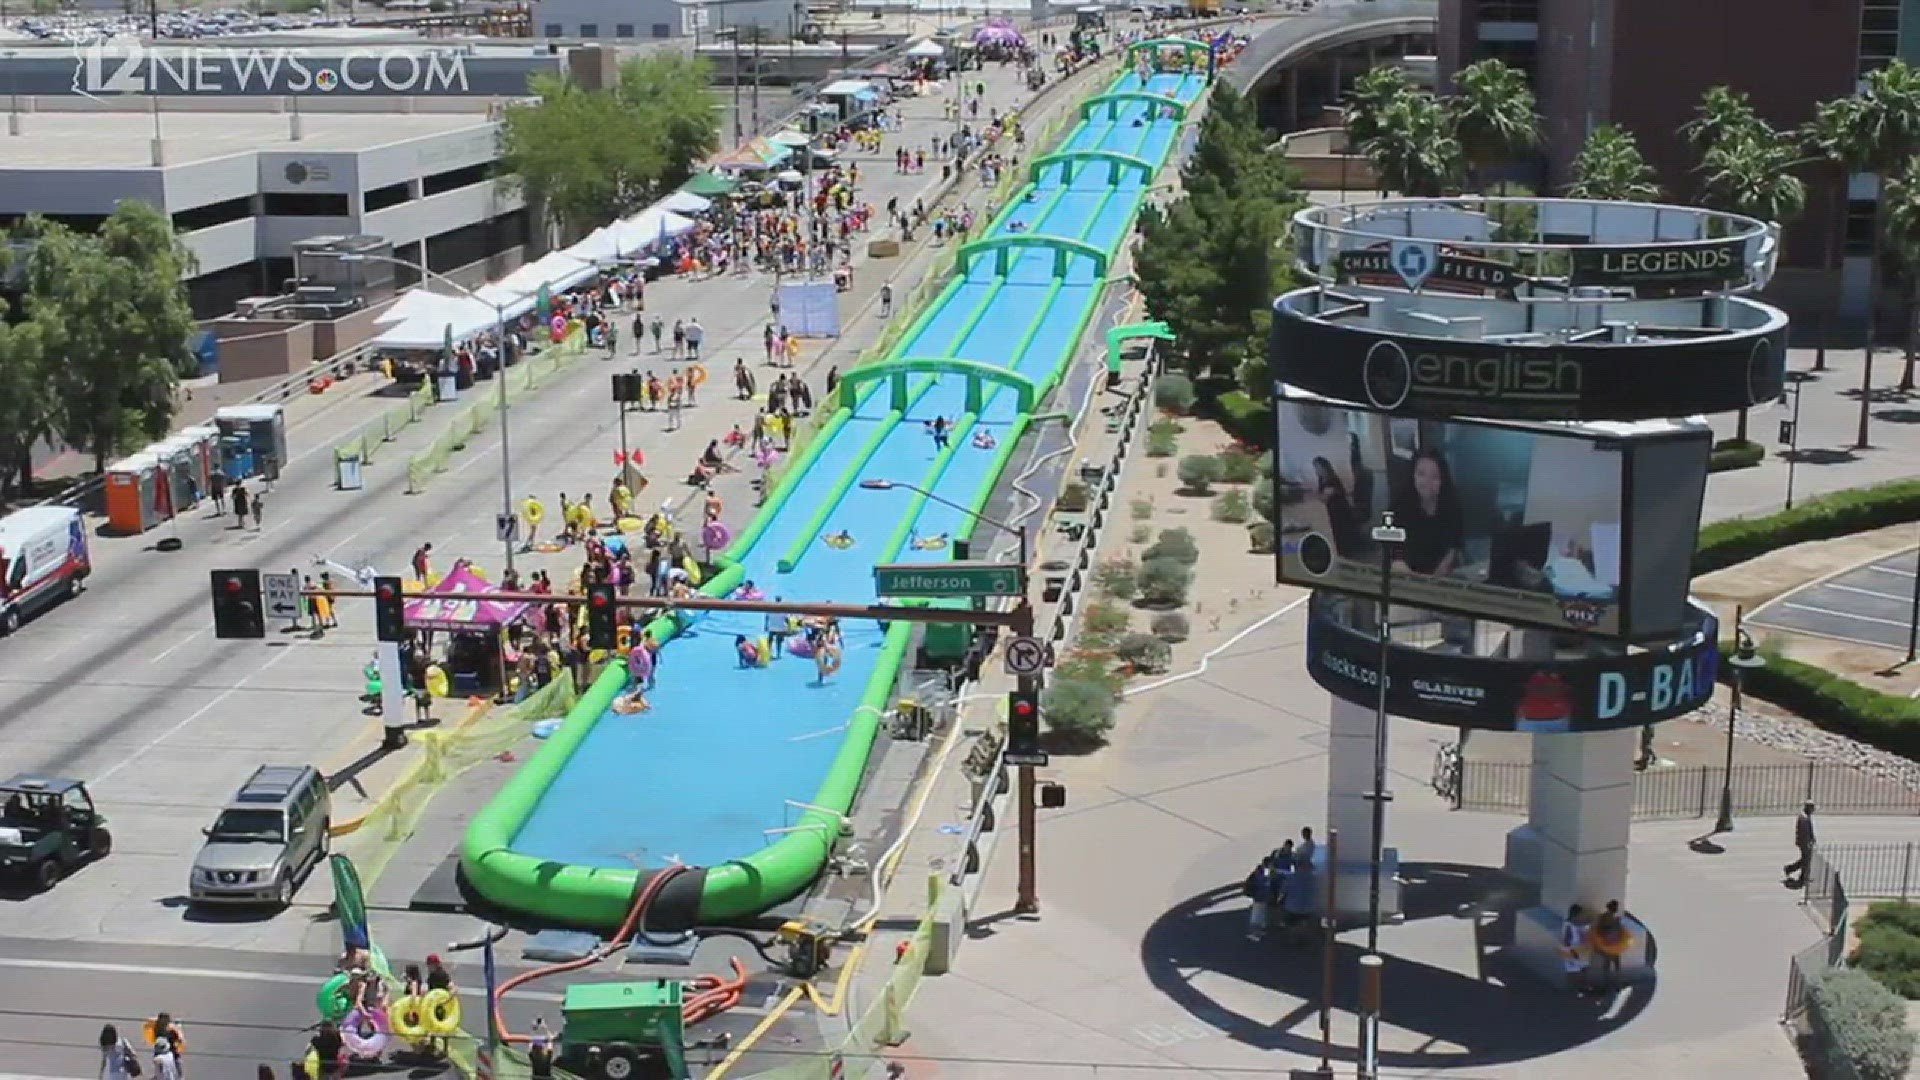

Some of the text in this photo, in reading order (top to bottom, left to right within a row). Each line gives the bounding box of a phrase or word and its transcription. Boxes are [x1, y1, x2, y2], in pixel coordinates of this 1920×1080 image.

[1602, 247, 1731, 273] LEGENDS
[1344, 255, 1504, 283] CHASE FIELD
[1413, 352, 1583, 397] english
[268, 577, 293, 588] ONE
[891, 575, 971, 590] Jefferson
[269, 590, 294, 599] WAY
[1565, 607, 1596, 622] PHX
